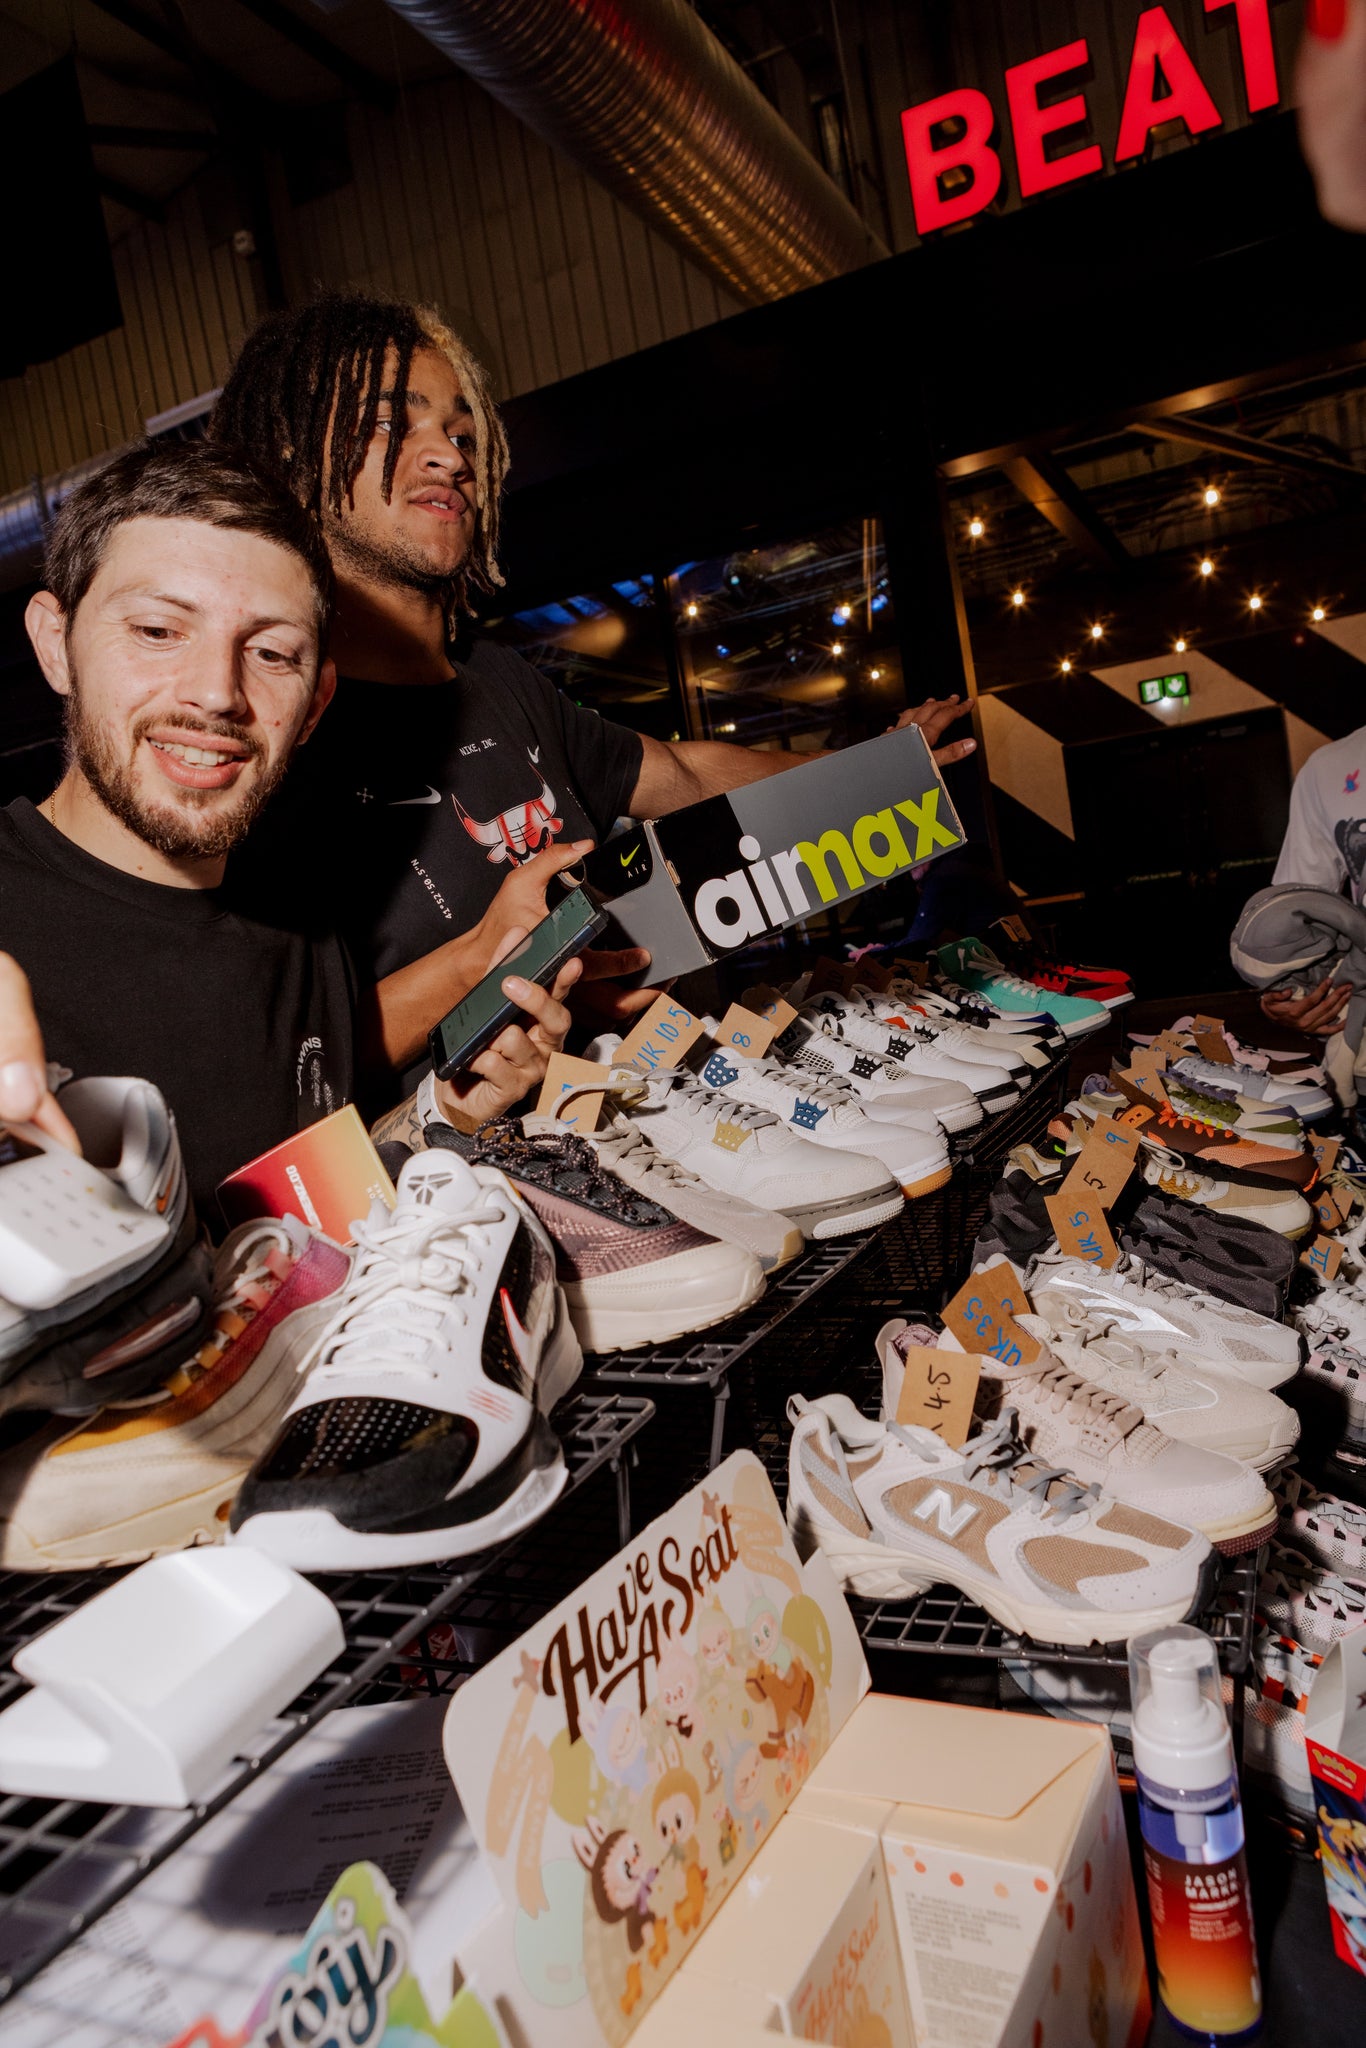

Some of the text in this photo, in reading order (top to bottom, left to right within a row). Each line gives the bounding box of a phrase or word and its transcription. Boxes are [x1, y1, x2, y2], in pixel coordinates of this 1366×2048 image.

[901, 0, 1280, 236] BEAT
[459, 738, 497, 757] NIKE, INC.
[627, 863, 647, 878] AIR
[655, 1005, 692, 1043] 10.5
[732, 1032, 750, 1048] 8
[1083, 1171, 1107, 1190] 5
[1069, 1211, 1104, 1263] UK 5
[1309, 1246, 1331, 1273] 11
[963, 1296, 993, 1337] 3.5
[988, 1327, 1023, 1367] UK
[923, 1364, 951, 1410] 4.5
[914, 1486, 977, 1537] N
[599, 1504, 739, 1717] A Seat
[542, 1552, 654, 1745] Have
[1185, 1867, 1237, 1887] JASON
